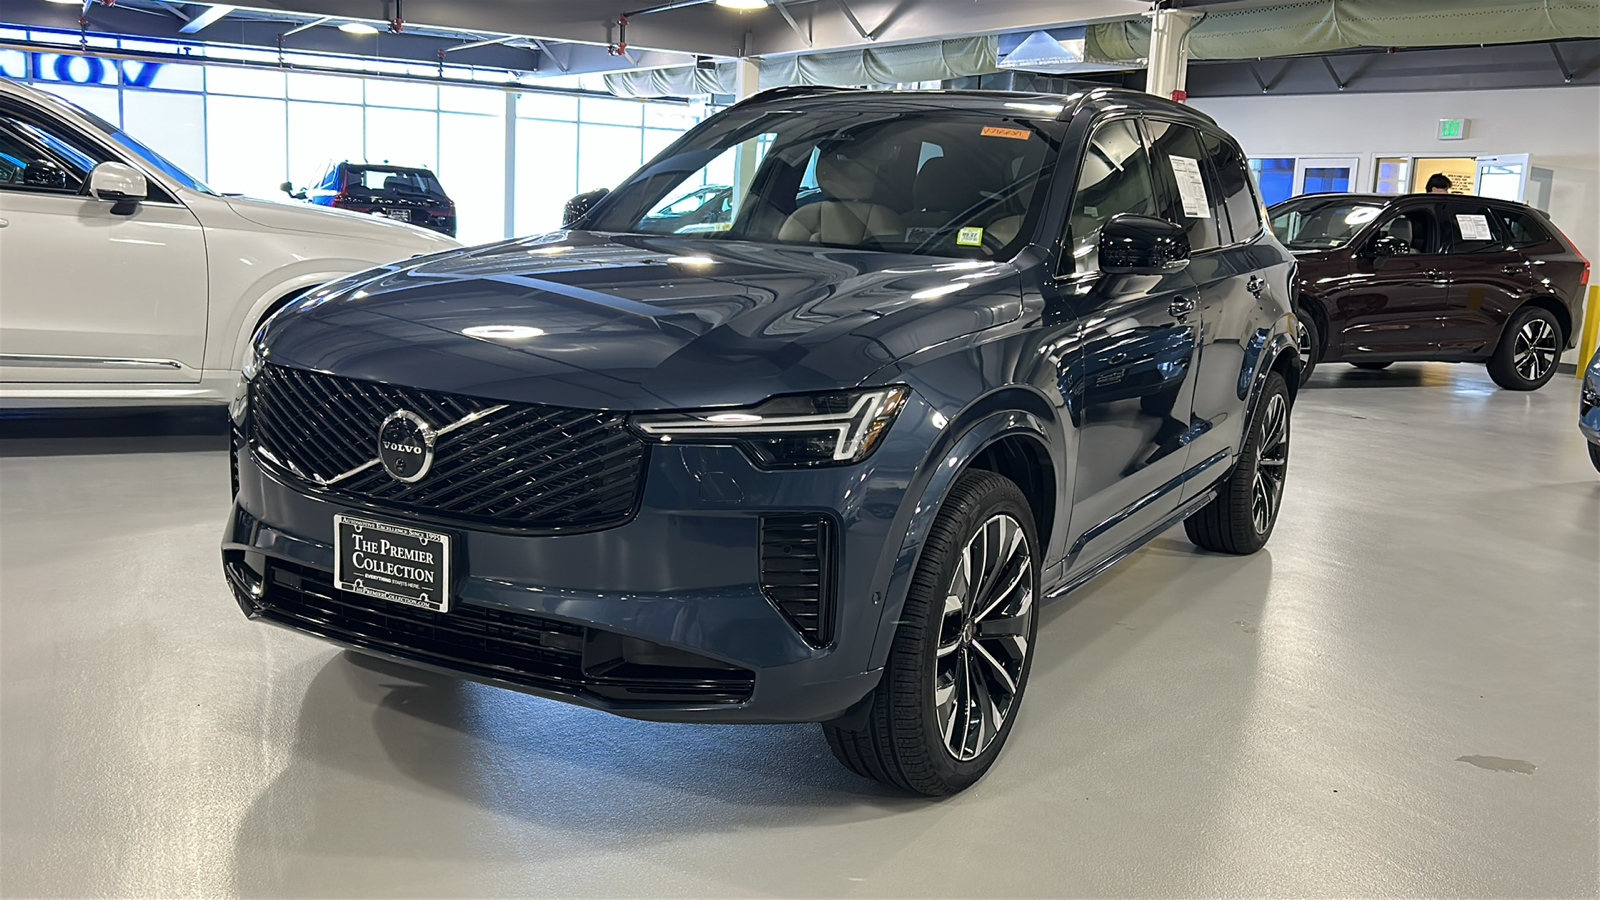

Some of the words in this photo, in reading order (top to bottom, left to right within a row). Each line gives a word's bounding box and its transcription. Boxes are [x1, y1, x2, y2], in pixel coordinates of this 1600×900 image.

[1441, 120, 1460, 137] EXIT
[382, 441, 422, 454] VOLVO
[342, 517, 375, 529] AUTOMOTIVE
[376, 523, 407, 534] EXCELLENCE
[409, 528, 425, 538] SINCE
[352, 533, 378, 554] THE
[380, 539, 434, 565] PREMIER
[352, 551, 434, 583] COLLECTION
[364, 573, 392, 584] EVERYTHING
[392, 578, 407, 588] STARTS
